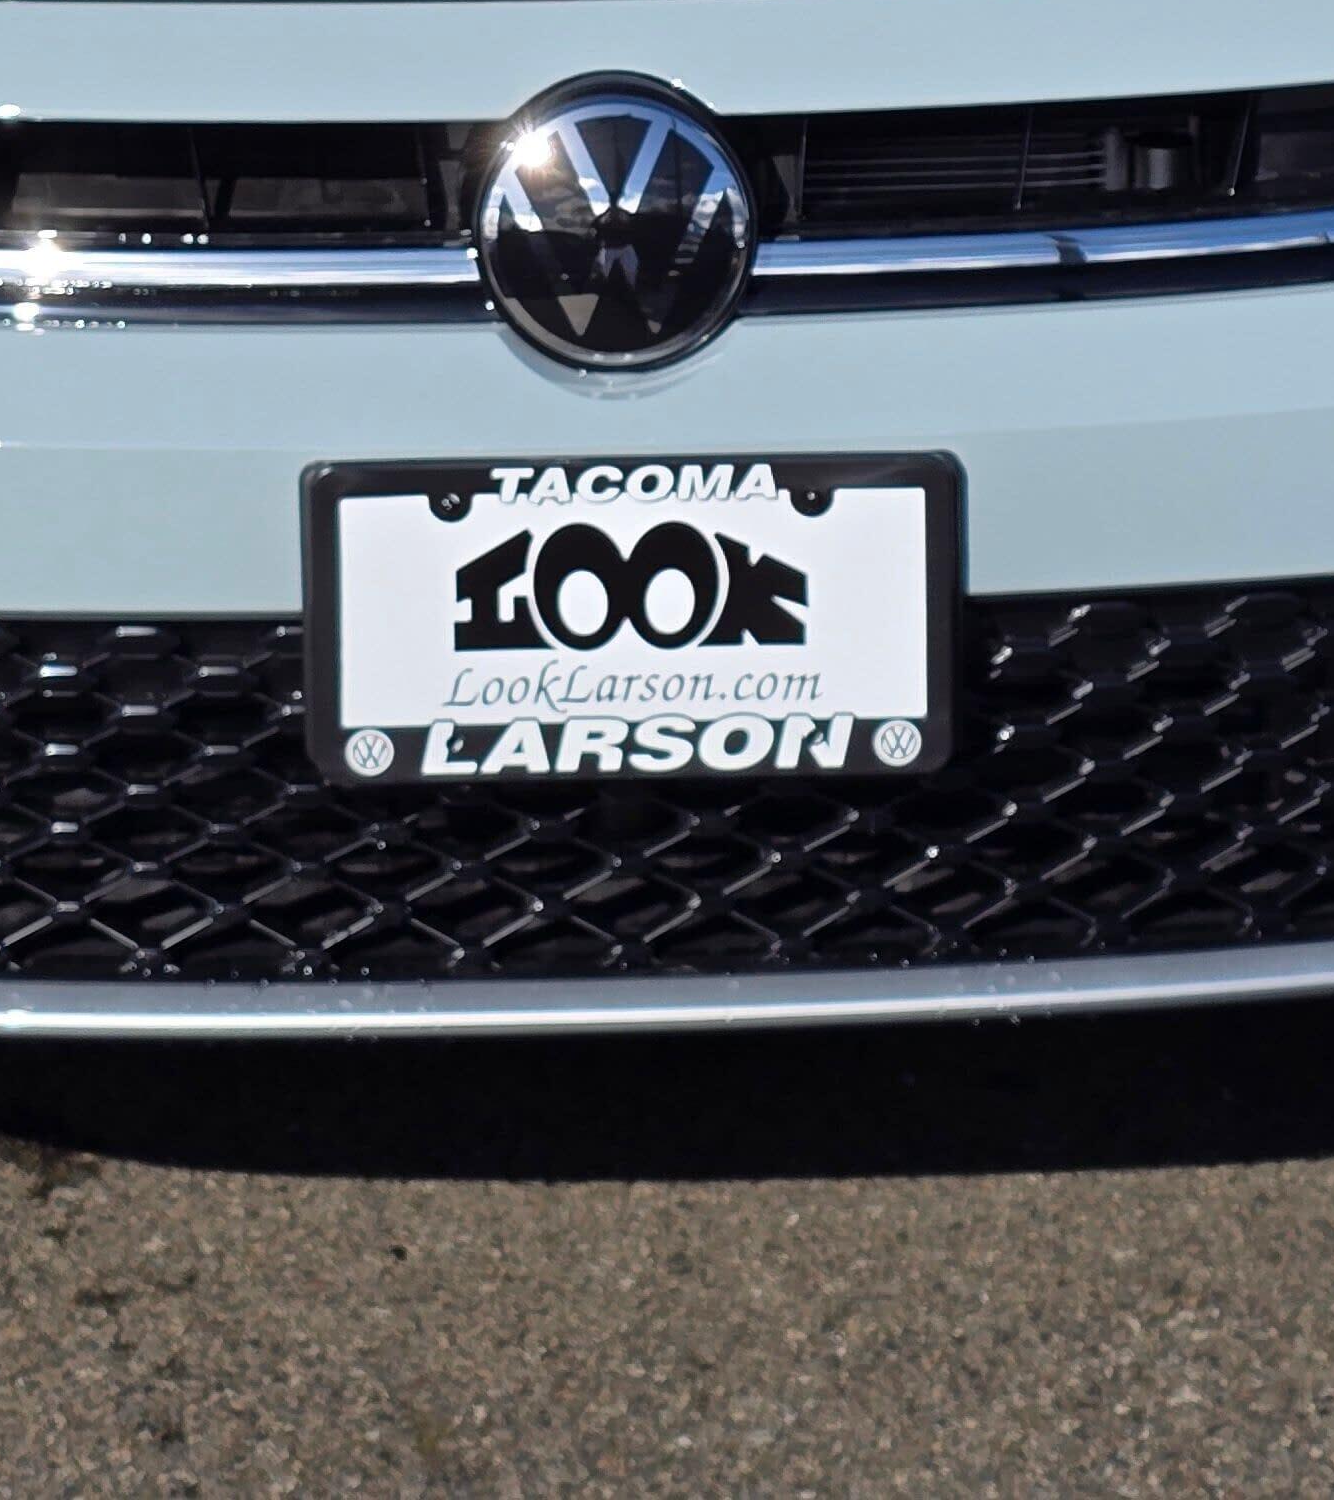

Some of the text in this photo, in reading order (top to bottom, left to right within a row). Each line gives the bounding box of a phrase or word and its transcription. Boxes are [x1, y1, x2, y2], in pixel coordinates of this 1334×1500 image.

[481, 96, 750, 366] VW
[490, 463, 779, 504] TACOMA
[454, 521, 808, 652] LOOK
[443, 660, 823, 714] LookLarson.com
[420, 712, 856, 776] LARSON
